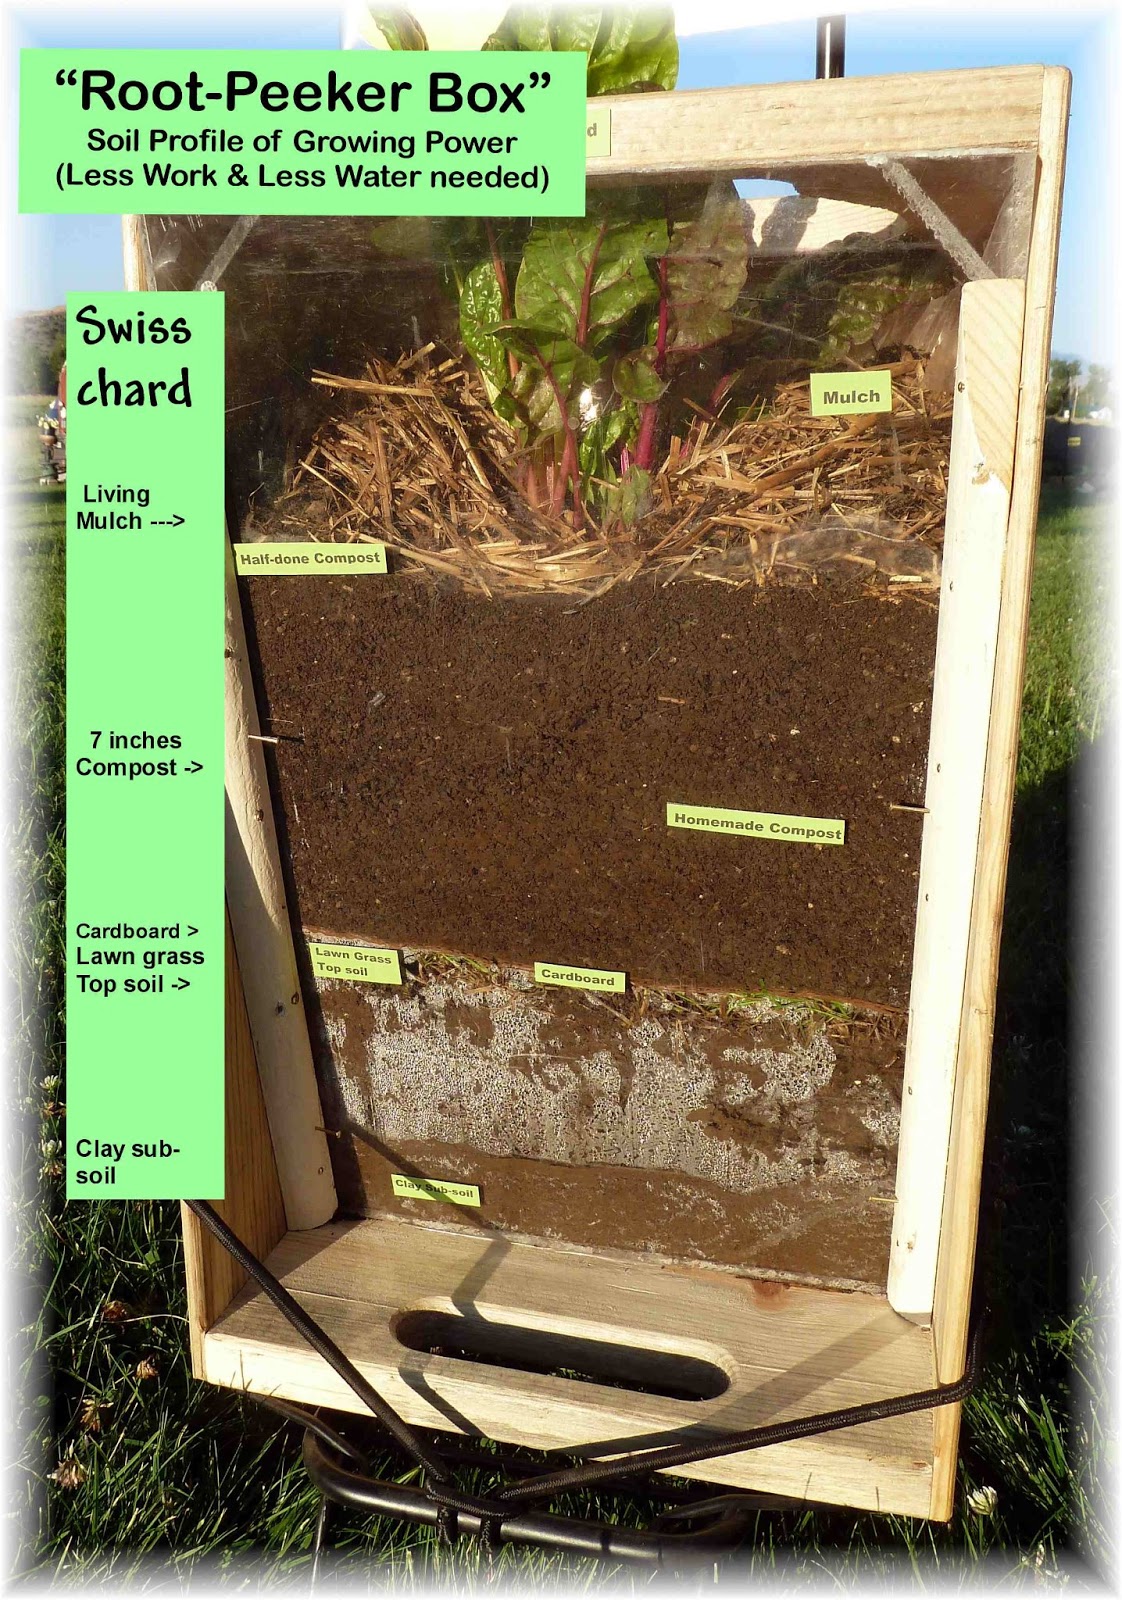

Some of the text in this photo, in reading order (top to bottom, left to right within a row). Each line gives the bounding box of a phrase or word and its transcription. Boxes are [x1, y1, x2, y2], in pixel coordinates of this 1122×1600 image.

[823, 389, 880, 405] Mulch
[240, 551, 381, 565] Half-done Compost
[674, 812, 842, 840] Homemade Compost
[315, 947, 392, 965] Lawn Grass
[316, 961, 368, 977] Top soil
[541, 969, 615, 987] Cardboard
[395, 1179, 474, 1198] Clay Sub-soil
